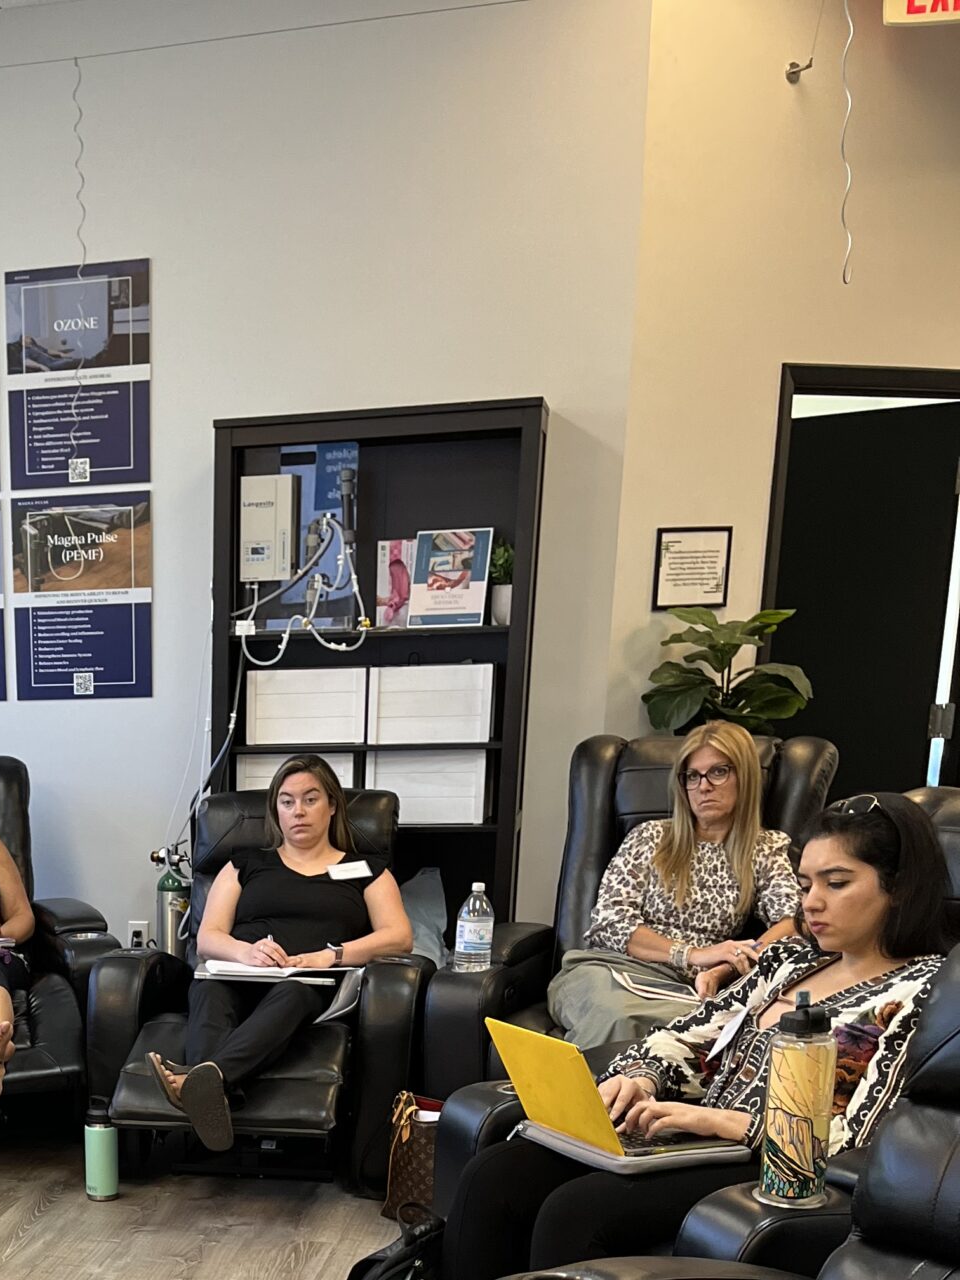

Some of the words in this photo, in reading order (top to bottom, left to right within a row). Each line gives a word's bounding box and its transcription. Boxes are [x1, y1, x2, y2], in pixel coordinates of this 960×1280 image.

[53, 317, 99, 332] OZONE
[47, 534, 85, 548] Magna
[87, 531, 118, 544] Pulse
[61, 547, 104, 564] (PEMF)
